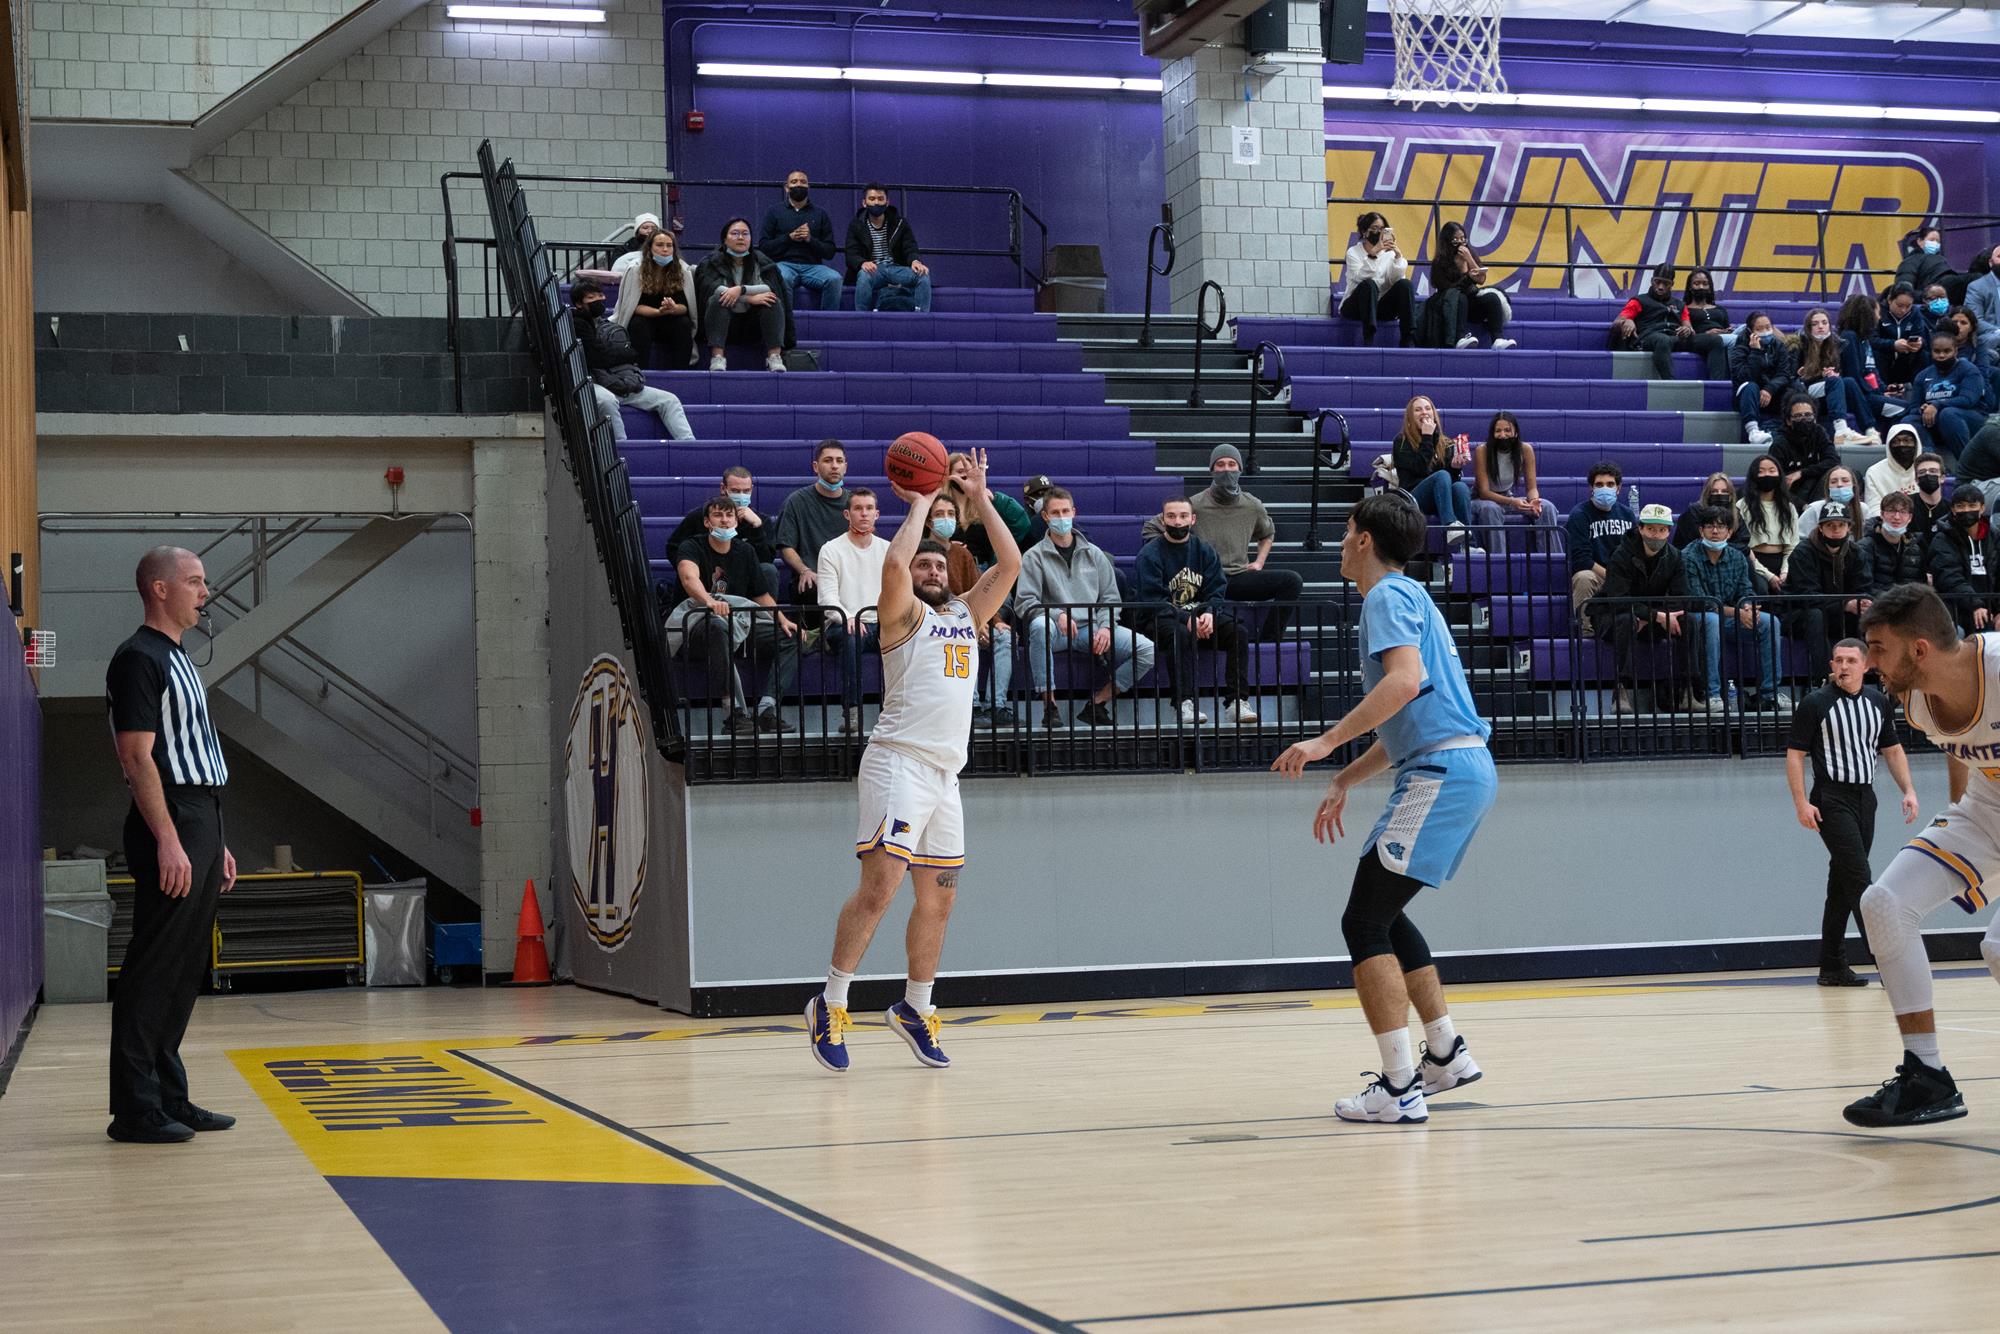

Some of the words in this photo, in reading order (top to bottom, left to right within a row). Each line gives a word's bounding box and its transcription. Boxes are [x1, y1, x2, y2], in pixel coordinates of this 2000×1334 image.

[890, 443, 926, 465] Wilson
[943, 644, 970, 679] 15
[263, 1055, 547, 1132] HUNTER
